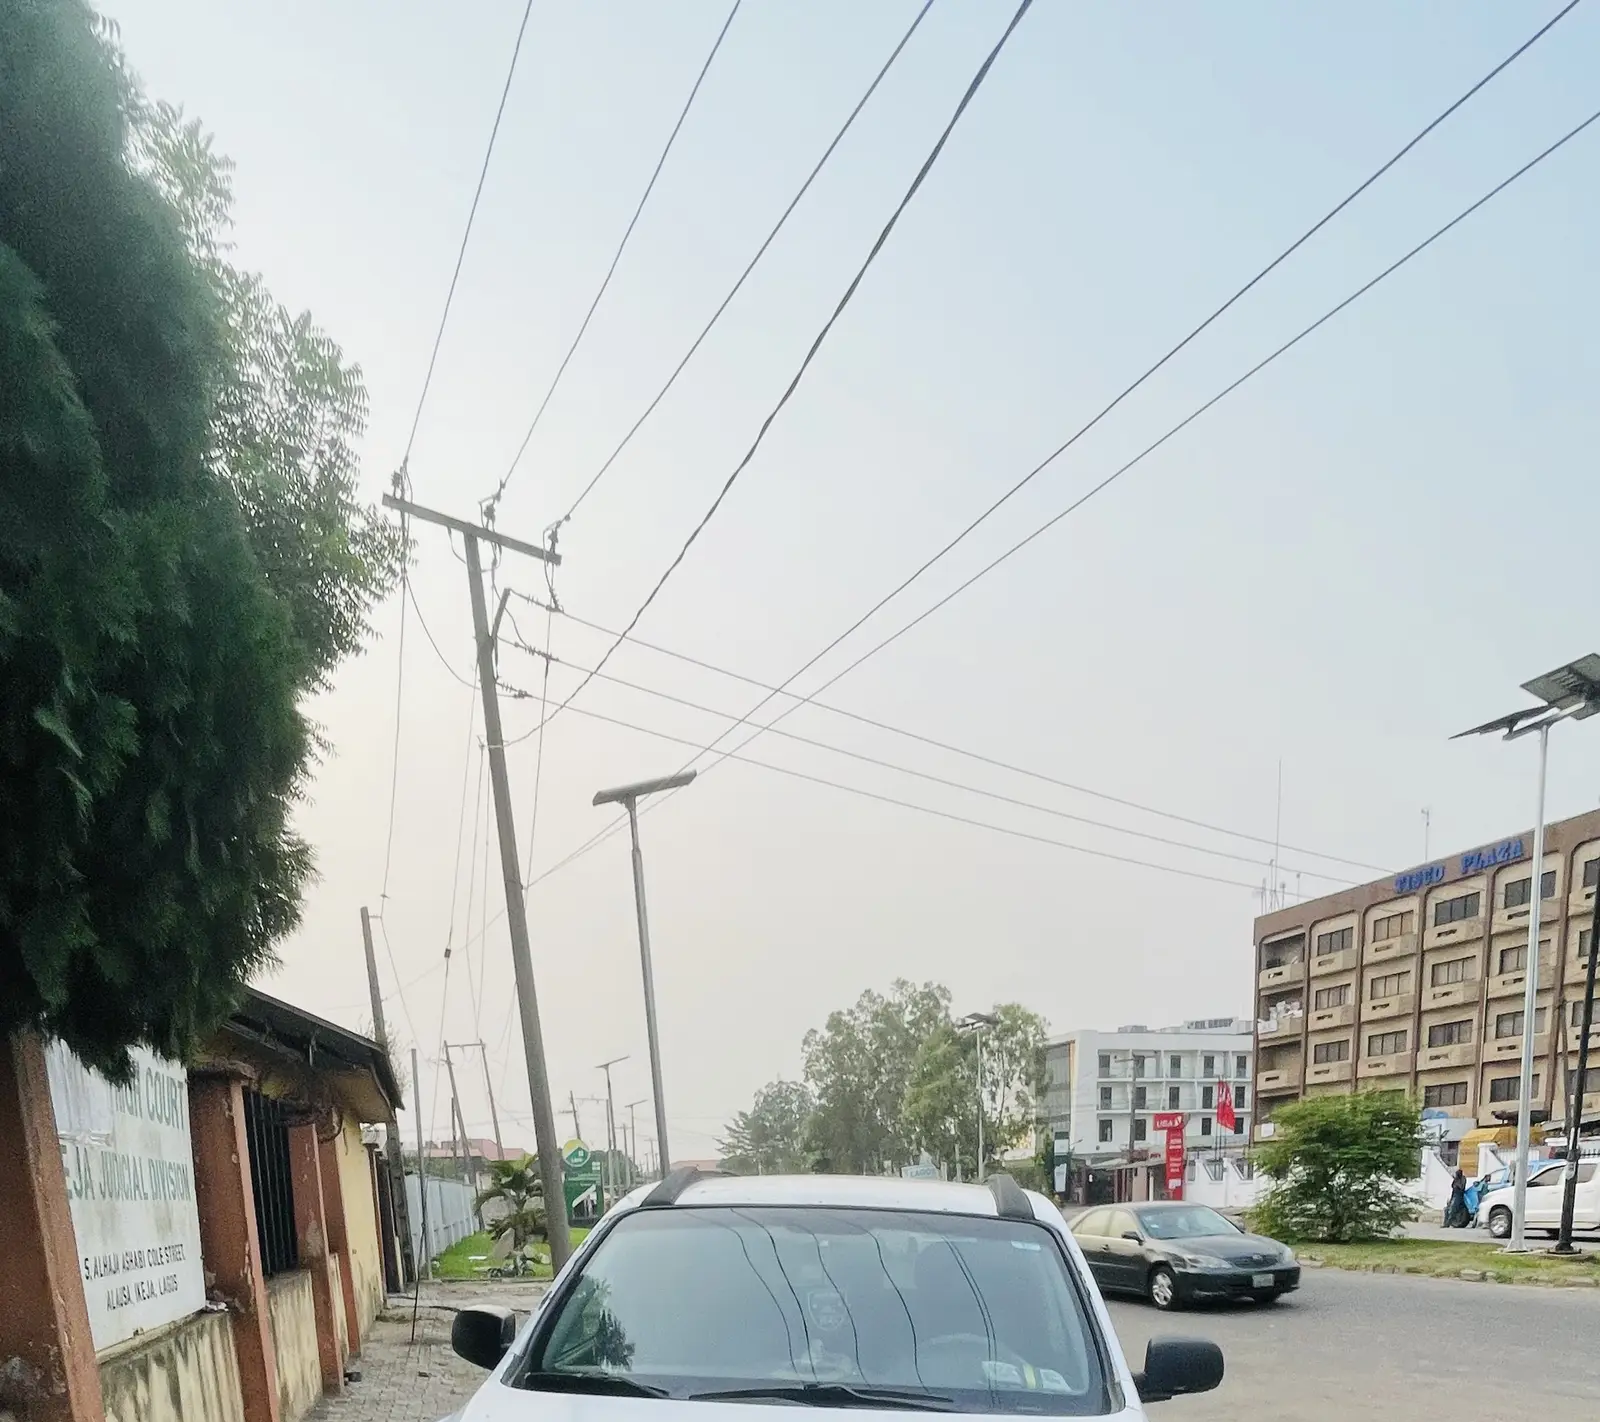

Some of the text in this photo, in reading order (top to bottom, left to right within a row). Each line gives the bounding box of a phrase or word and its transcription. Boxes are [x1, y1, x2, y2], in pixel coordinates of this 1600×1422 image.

[1461, 839, 1524, 874] PLAZA
[145, 1066, 185, 1131] COURT
[99, 1151, 149, 1201] JUDICIAL
[148, 1158, 192, 1202] DIVISION
[147, 1247, 165, 1268] COLE
[164, 1243, 187, 1264] STREET
[158, 1274, 179, 1296] LAGOS
